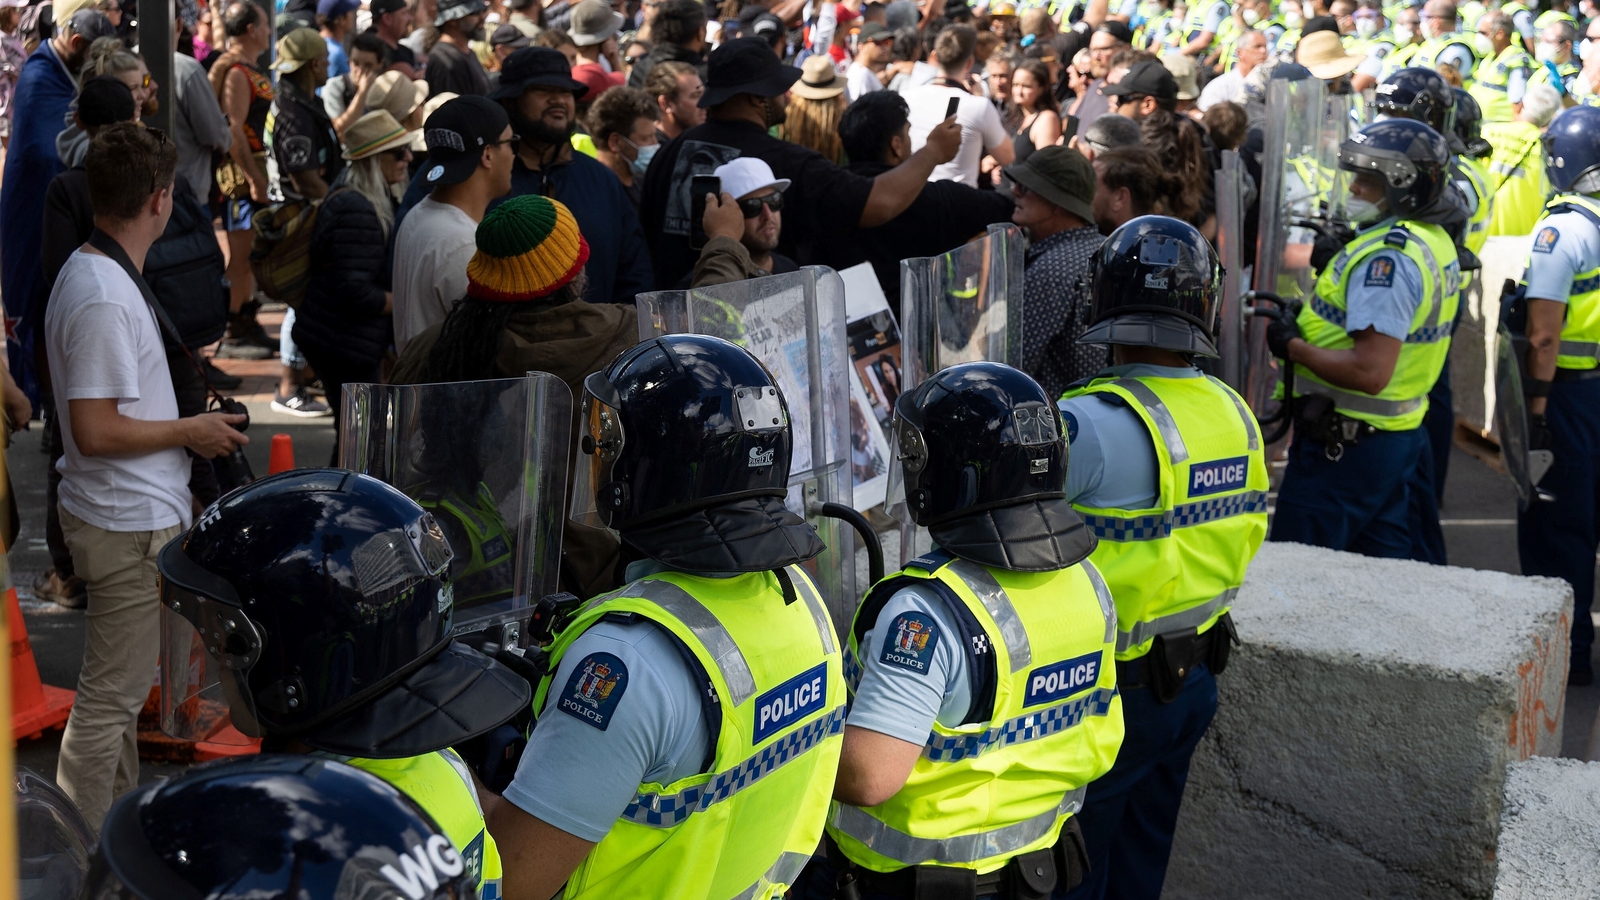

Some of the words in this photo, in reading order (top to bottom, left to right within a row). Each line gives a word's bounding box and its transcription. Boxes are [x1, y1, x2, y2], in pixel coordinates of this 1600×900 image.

[1193, 464, 1245, 489] POLICE
[885, 653, 924, 670] POLICE
[1031, 661, 1097, 697] POLICE
[562, 698, 603, 723] POLICE
[760, 676, 821, 731] POLICE
